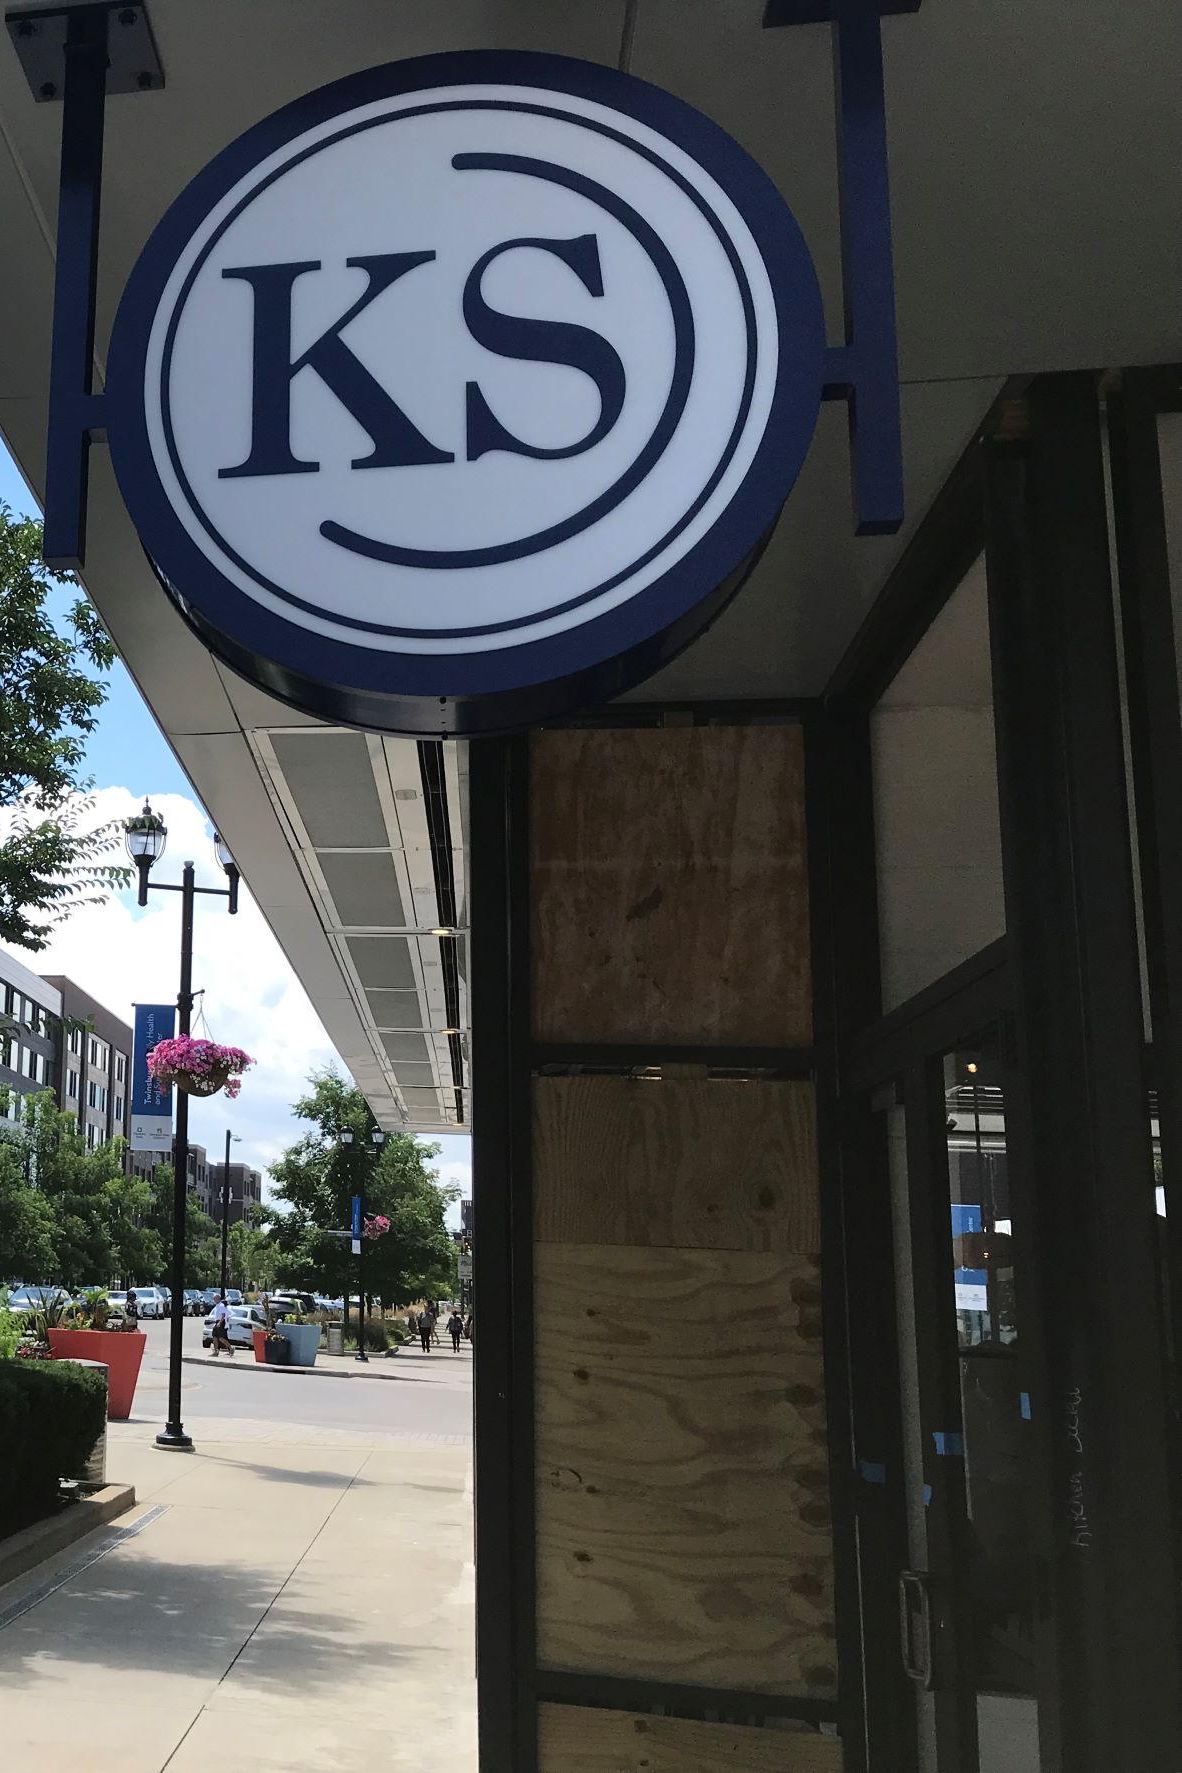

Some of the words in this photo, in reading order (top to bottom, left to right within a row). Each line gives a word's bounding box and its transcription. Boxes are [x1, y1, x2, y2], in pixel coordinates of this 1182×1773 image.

[218, 233, 627, 480] KS
[145, 1013, 154, 1039] Health
[153, 1090, 161, 1105] and
